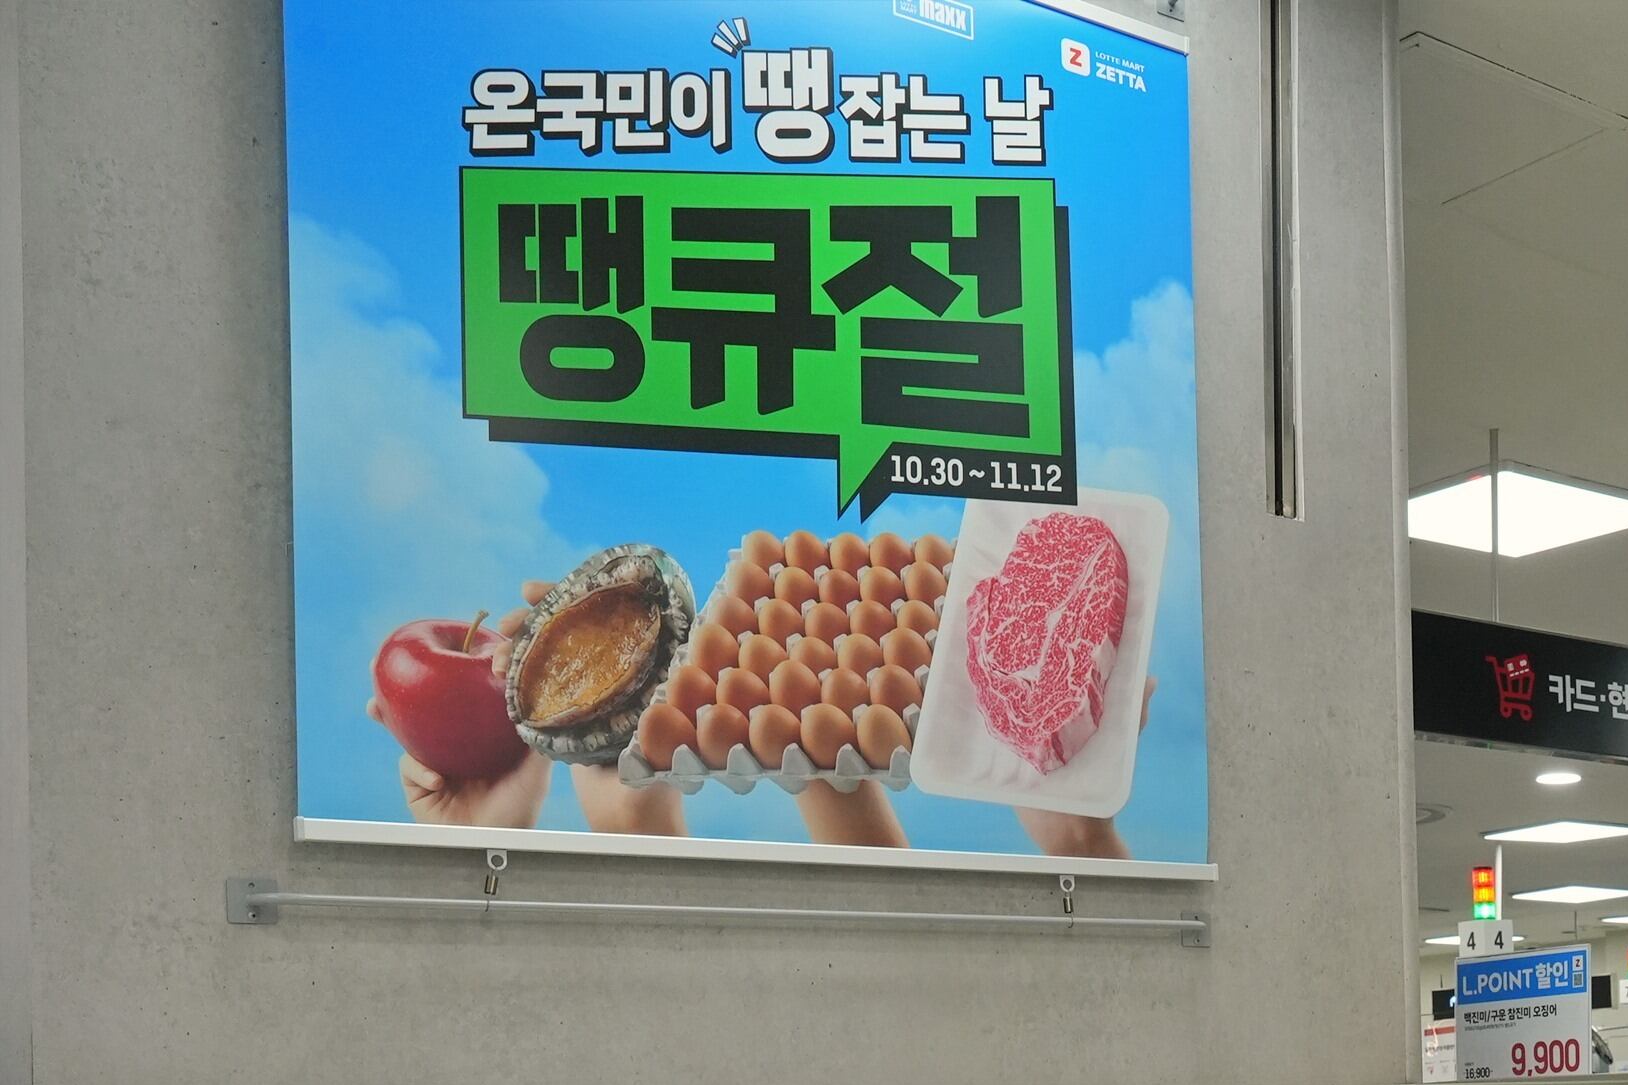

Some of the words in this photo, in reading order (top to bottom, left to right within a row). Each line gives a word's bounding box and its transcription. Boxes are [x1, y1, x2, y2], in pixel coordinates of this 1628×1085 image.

[1095, 51, 1120, 65] LOTTE
[1121, 58, 1145, 73] MART
[1095, 62, 1147, 92] ZETTA
[463, 68, 732, 157] 온국민이
[983, 75, 1053, 165] 날
[499, 196, 1030, 438] 땡큐절
[1467, 931, 1476, 950] 4
[1494, 931, 1504, 950] 4
[1462, 968, 1535, 997] L.POINT
[1535, 962, 1569, 990] 할인
[1507, 1006, 1531, 1021] 참진미
[1533, 1003, 1557, 1018] 오징어
[1511, 1038, 1580, 1077] 9,900
